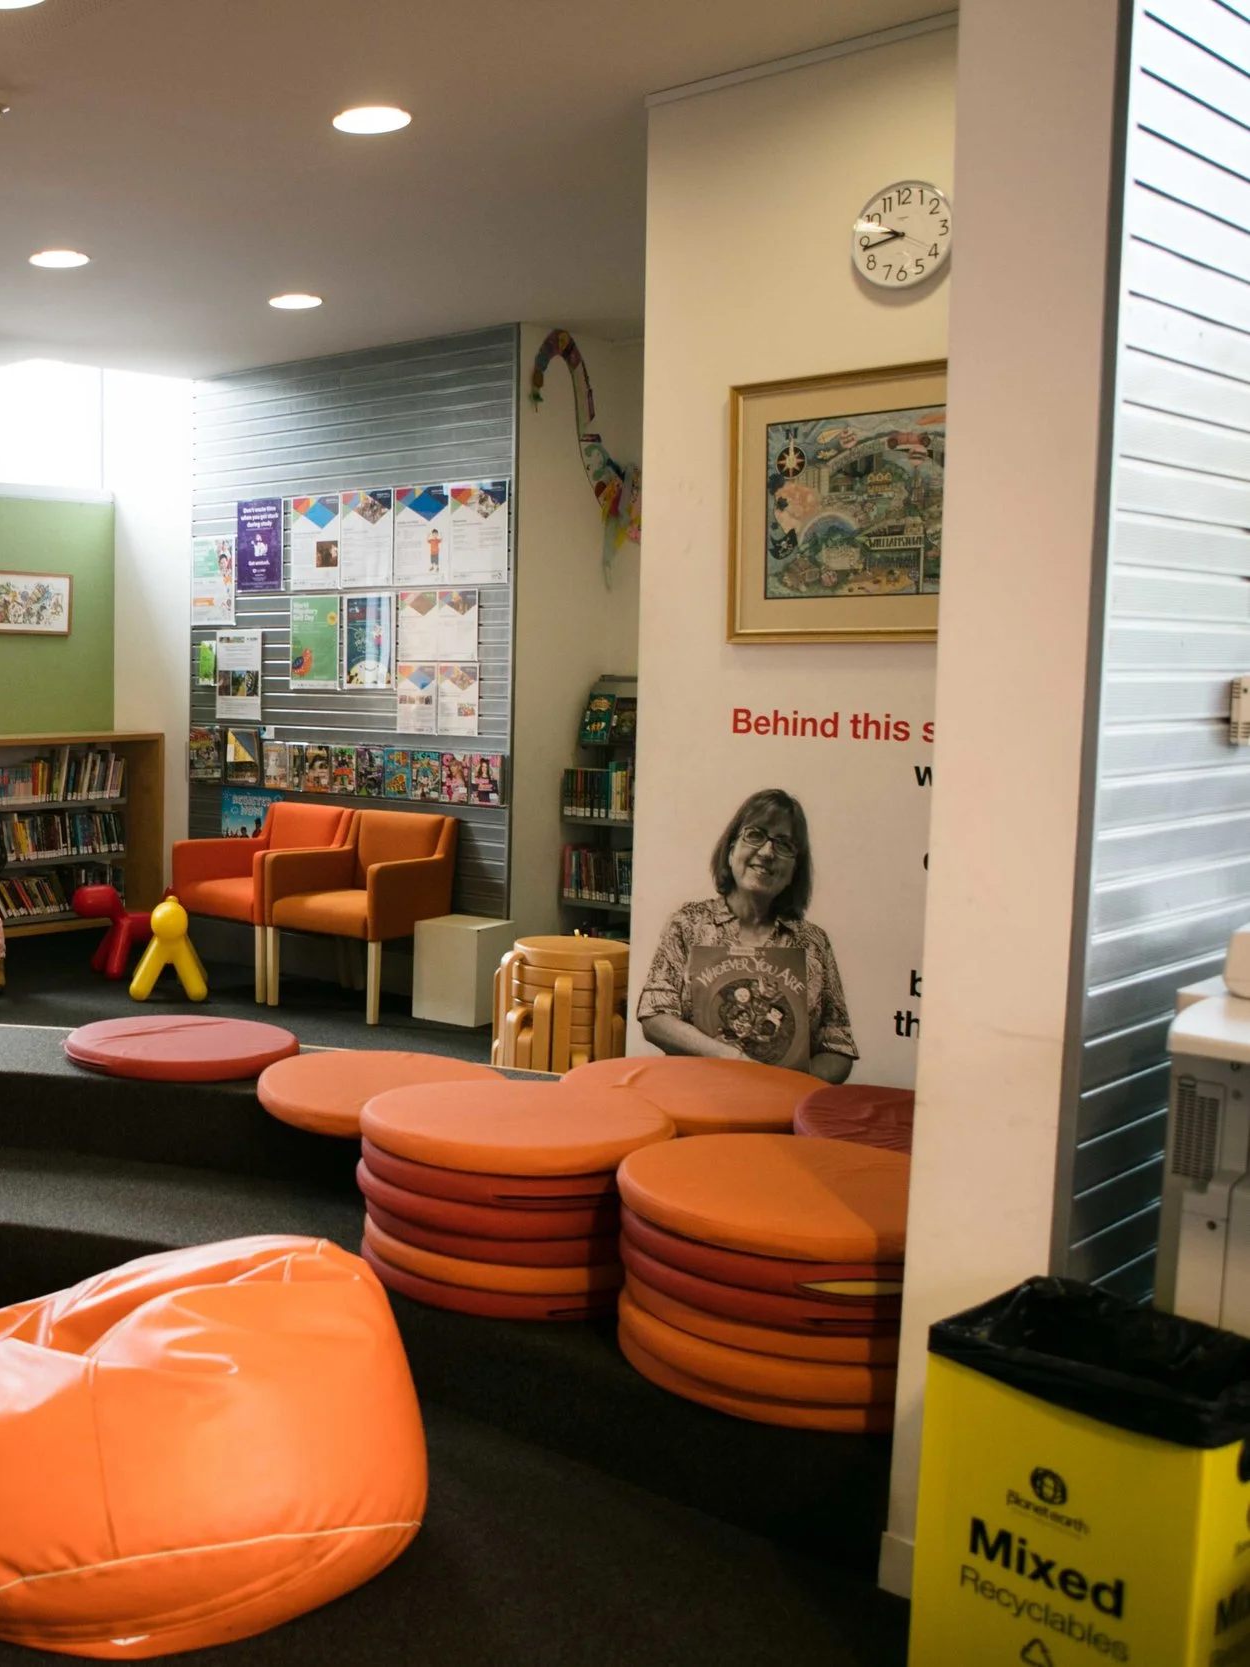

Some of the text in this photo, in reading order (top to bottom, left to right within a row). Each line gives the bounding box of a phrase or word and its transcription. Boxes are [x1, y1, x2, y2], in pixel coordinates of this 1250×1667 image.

[882, 197, 892, 213] 11
[896, 188, 912, 206] 12
[918, 189, 924, 205] 1
[929, 198, 940, 215] 2
[938, 219, 949, 236] 3
[928, 243, 940, 259] 4
[866, 254, 877, 270] 8
[914, 258, 925, 275] 5
[882, 264, 893, 280] 7
[896, 265, 907, 282] 6
[785, 427, 798, 440] N
[732, 708, 839, 739] Behind
[849, 712, 910, 742] this
[696, 957, 806, 994] WHOEVER YOU ARE
[969, 1516, 1125, 1620] Mixed
[960, 1564, 1129, 1662] Recyclables
